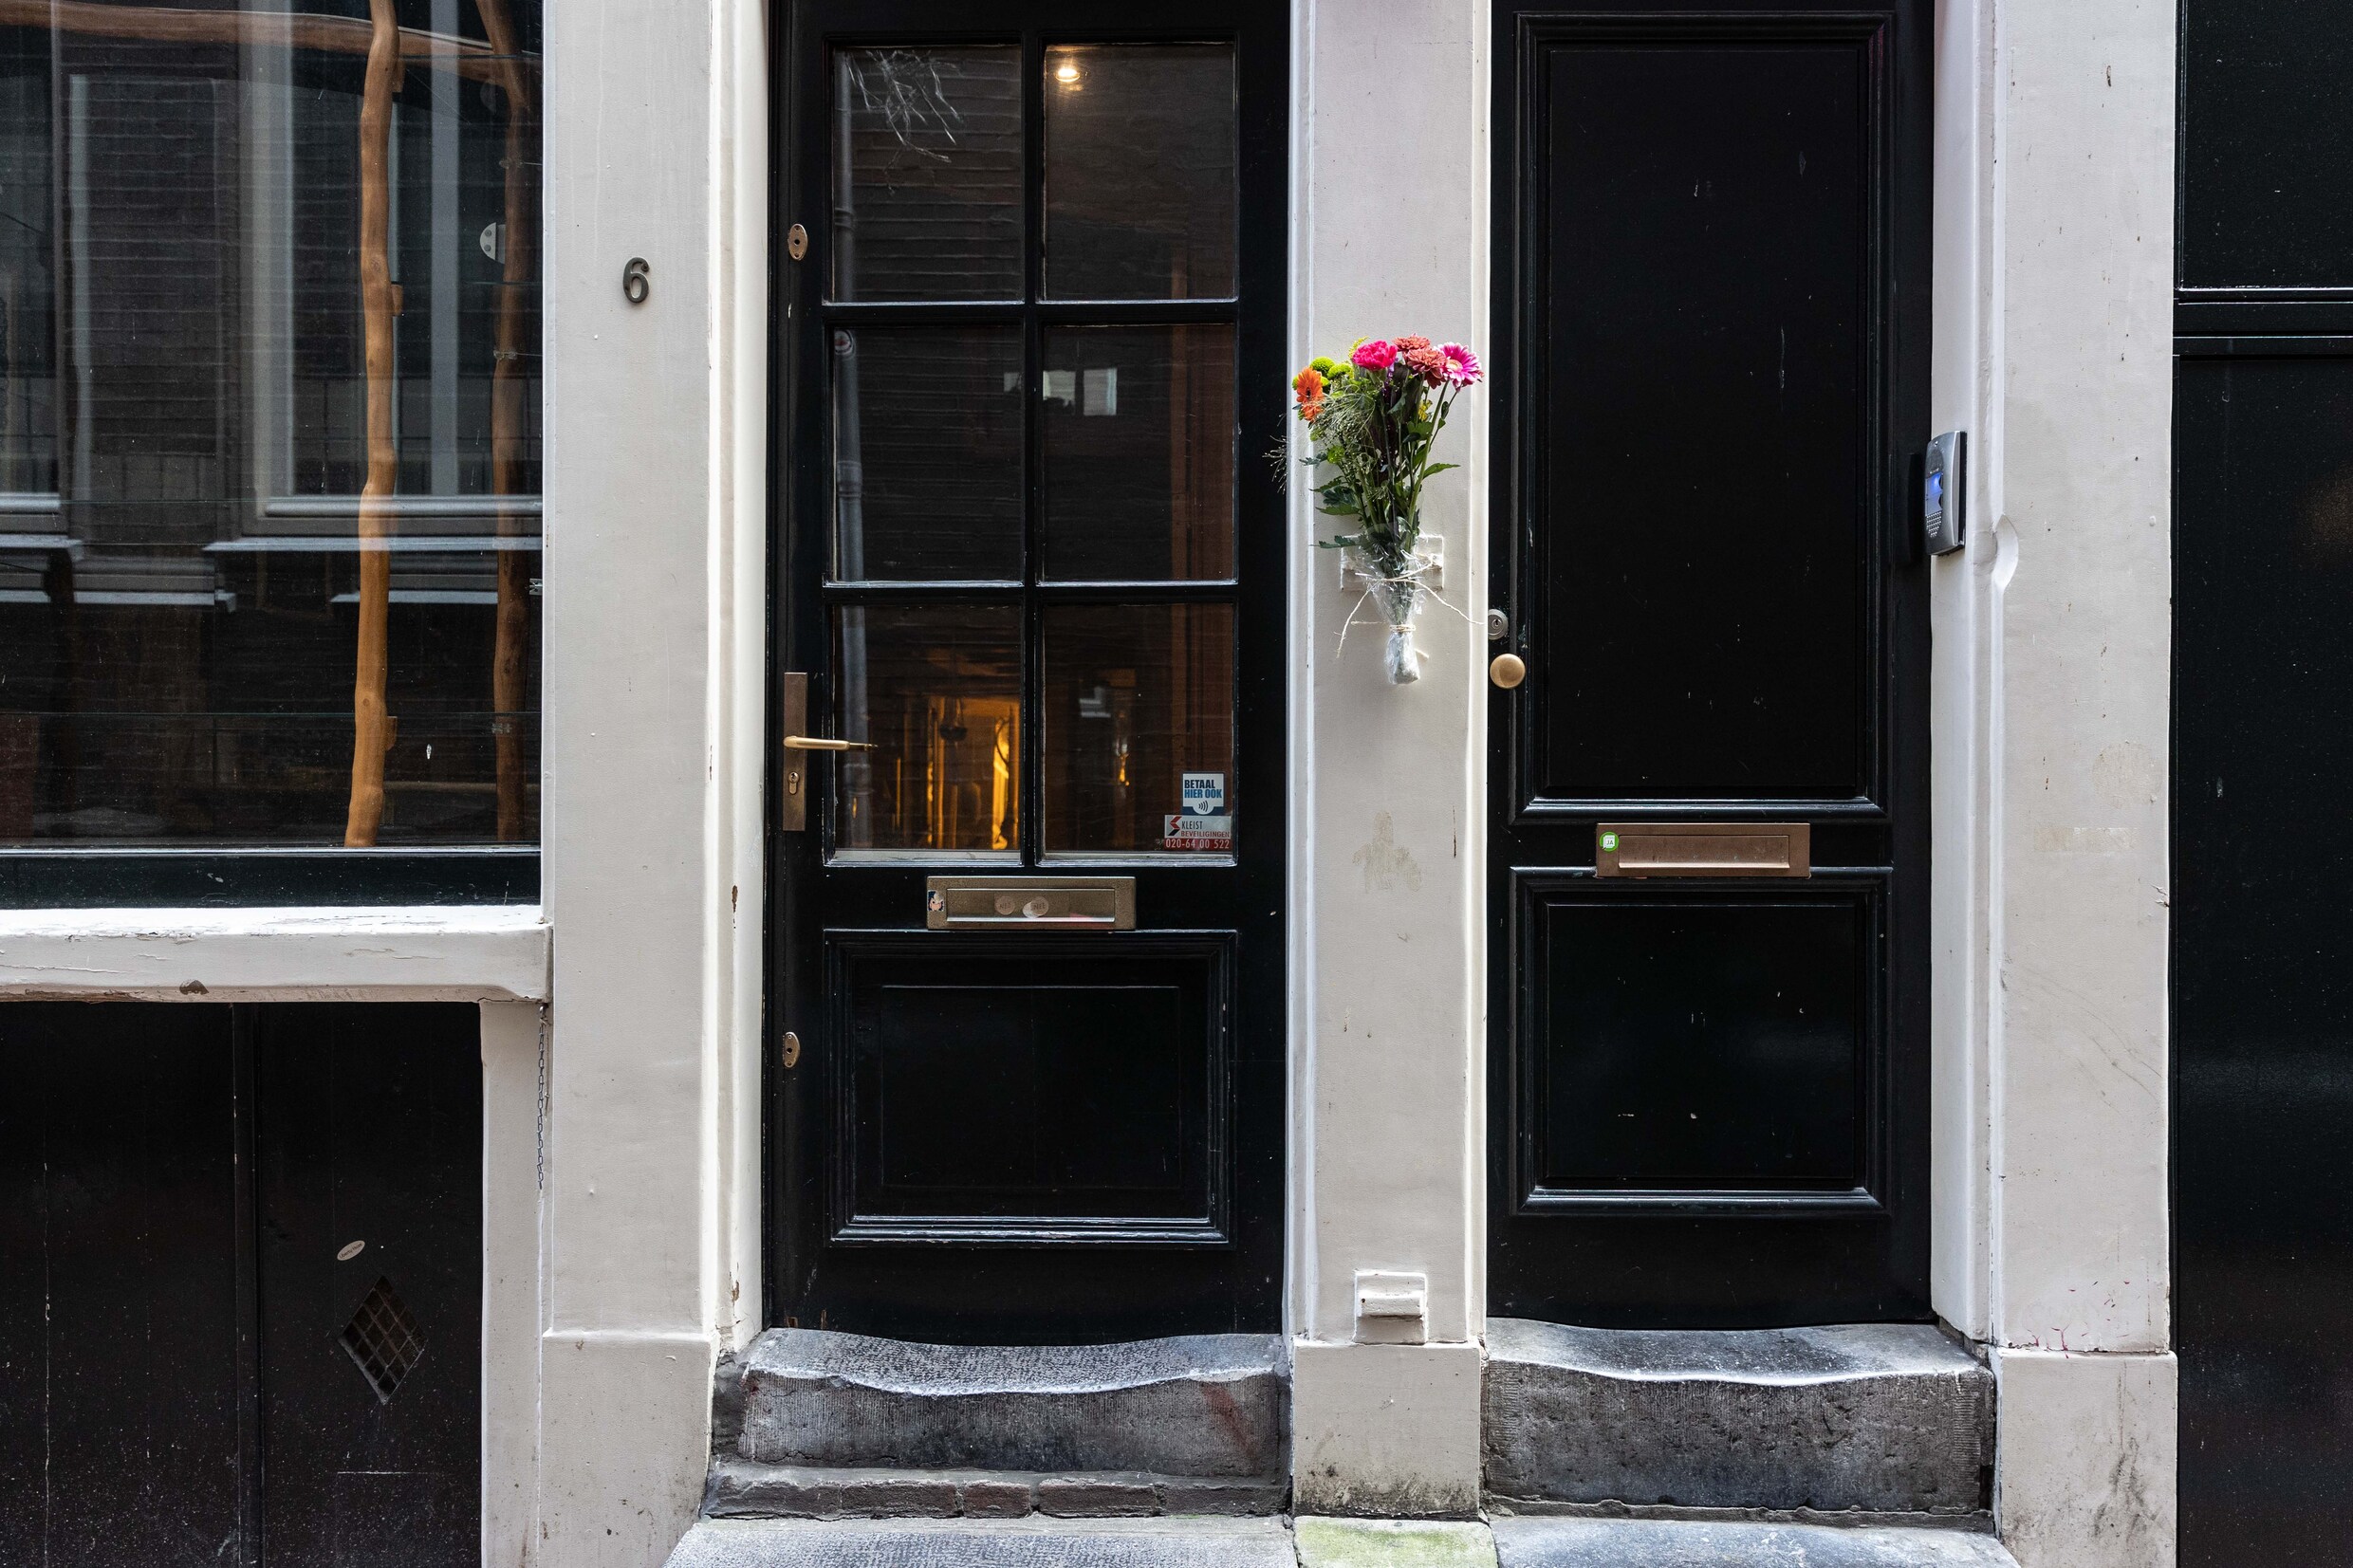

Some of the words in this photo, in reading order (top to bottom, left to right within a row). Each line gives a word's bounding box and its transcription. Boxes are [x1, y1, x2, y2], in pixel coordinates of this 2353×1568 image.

[622, 257, 650, 304] 6
[1184, 780, 1215, 788] BETAAL
[1184, 789, 1203, 798] HIER
[1205, 789, 1222, 798] OOK
[1181, 821, 1203, 829] KLEIST
[1165, 839, 1195, 848] 020-64
[1199, 839, 1210, 848] 00
[1214, 839, 1230, 848] 522
